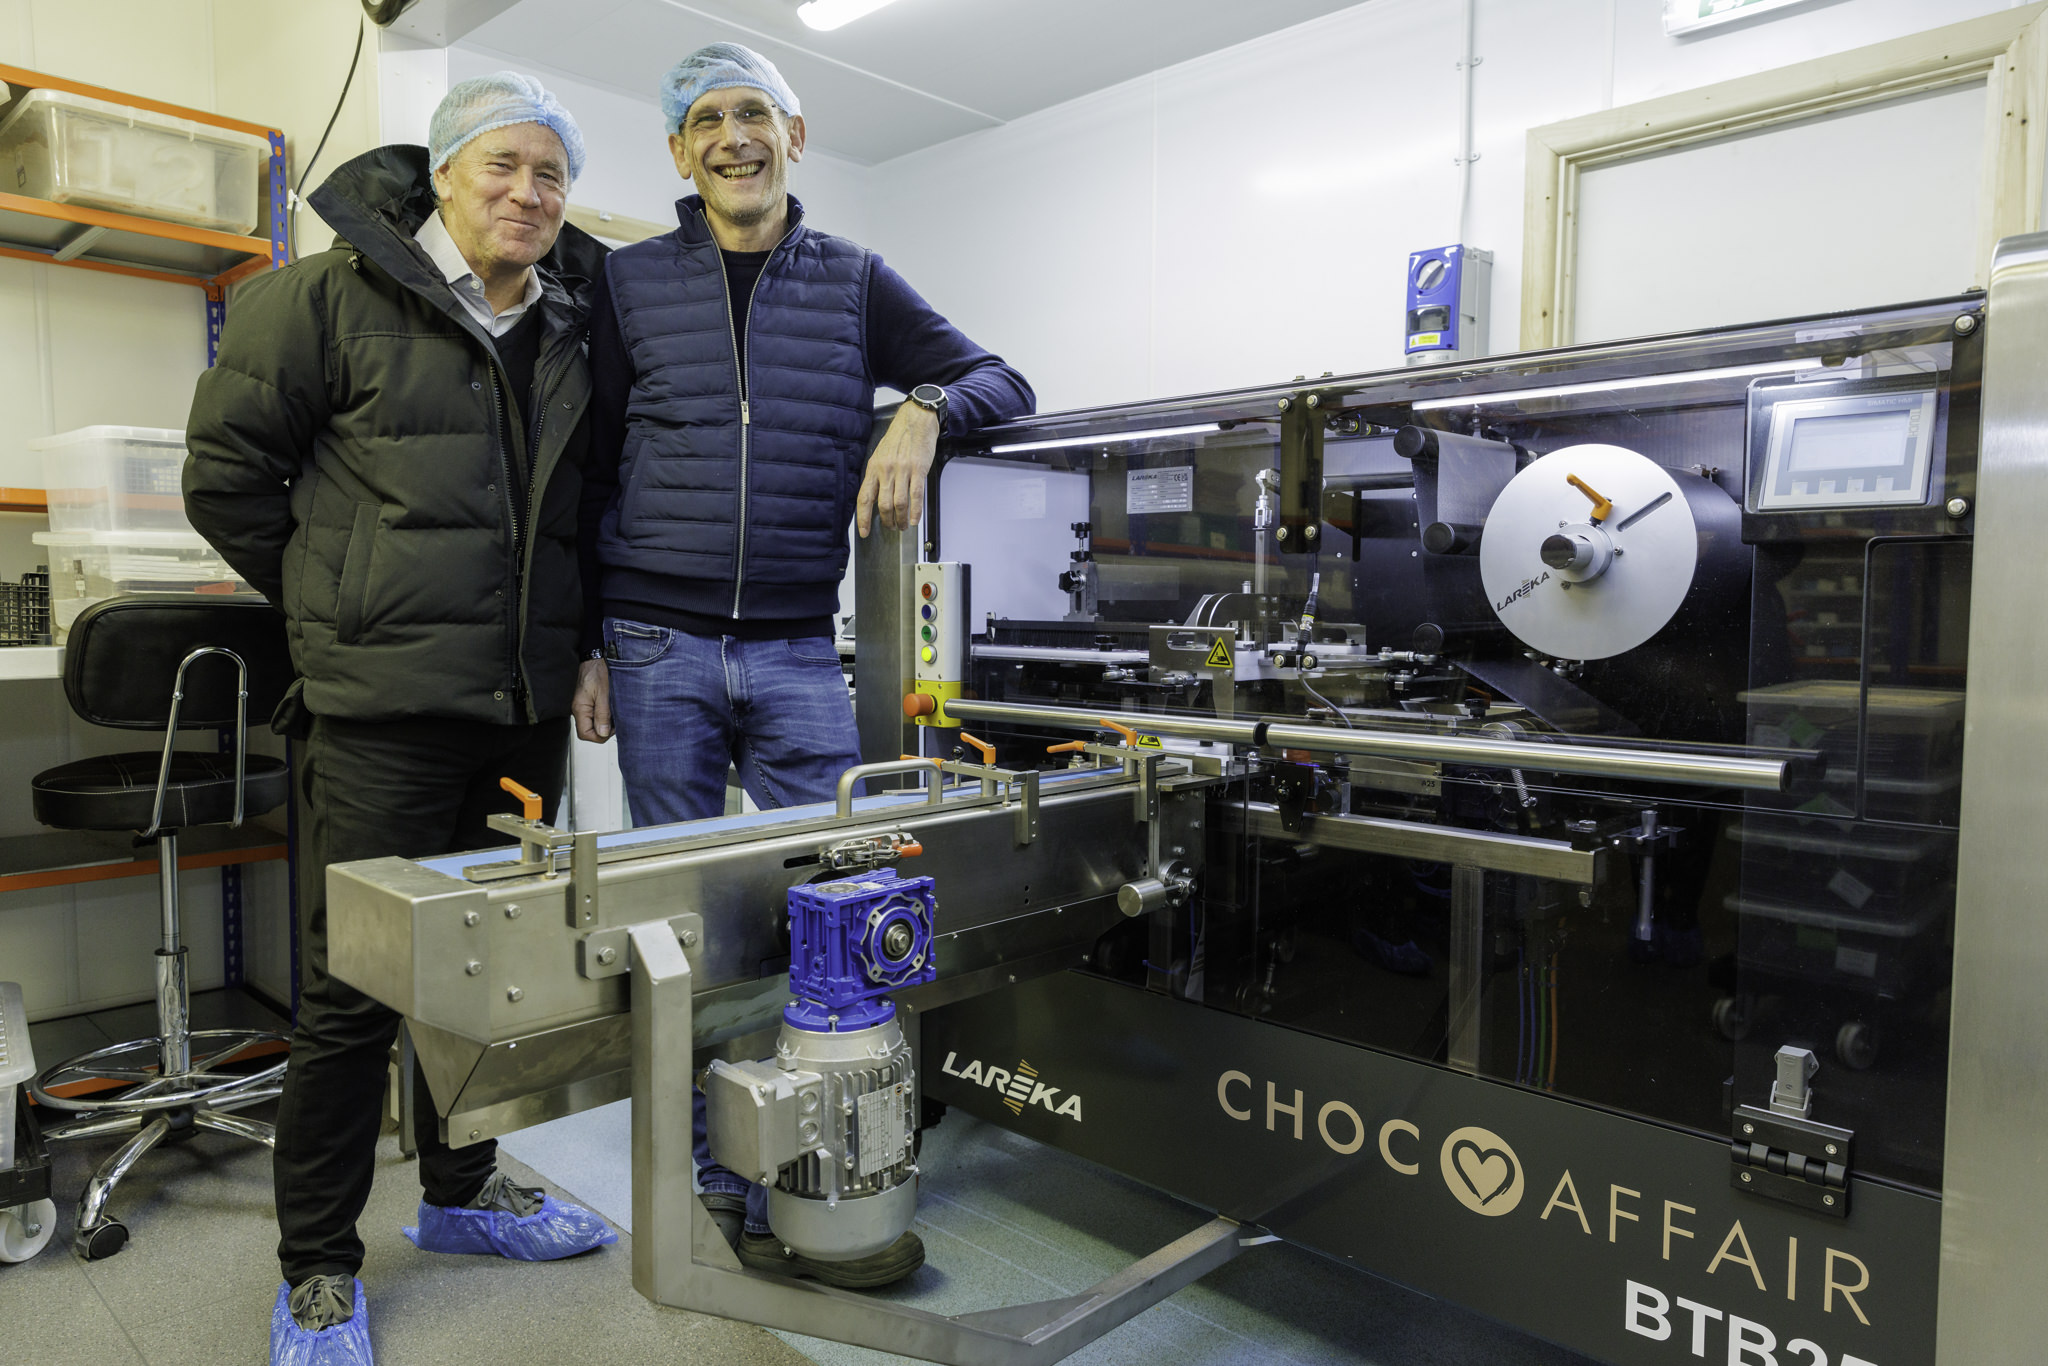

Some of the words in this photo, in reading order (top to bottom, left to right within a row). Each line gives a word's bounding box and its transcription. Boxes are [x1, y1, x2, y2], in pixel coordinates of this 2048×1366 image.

[1867, 398, 1896, 406] SIMATIC
[1908, 410, 1920, 437] TOUCH
[1496, 571, 1550, 612] LAREKA
[942, 1051, 1082, 1123] LAREKA
[1217, 1070, 1420, 1176] CHOC
[1540, 1169, 1871, 1326] AFFAIR
[1625, 1279, 1879, 1366] BTB
